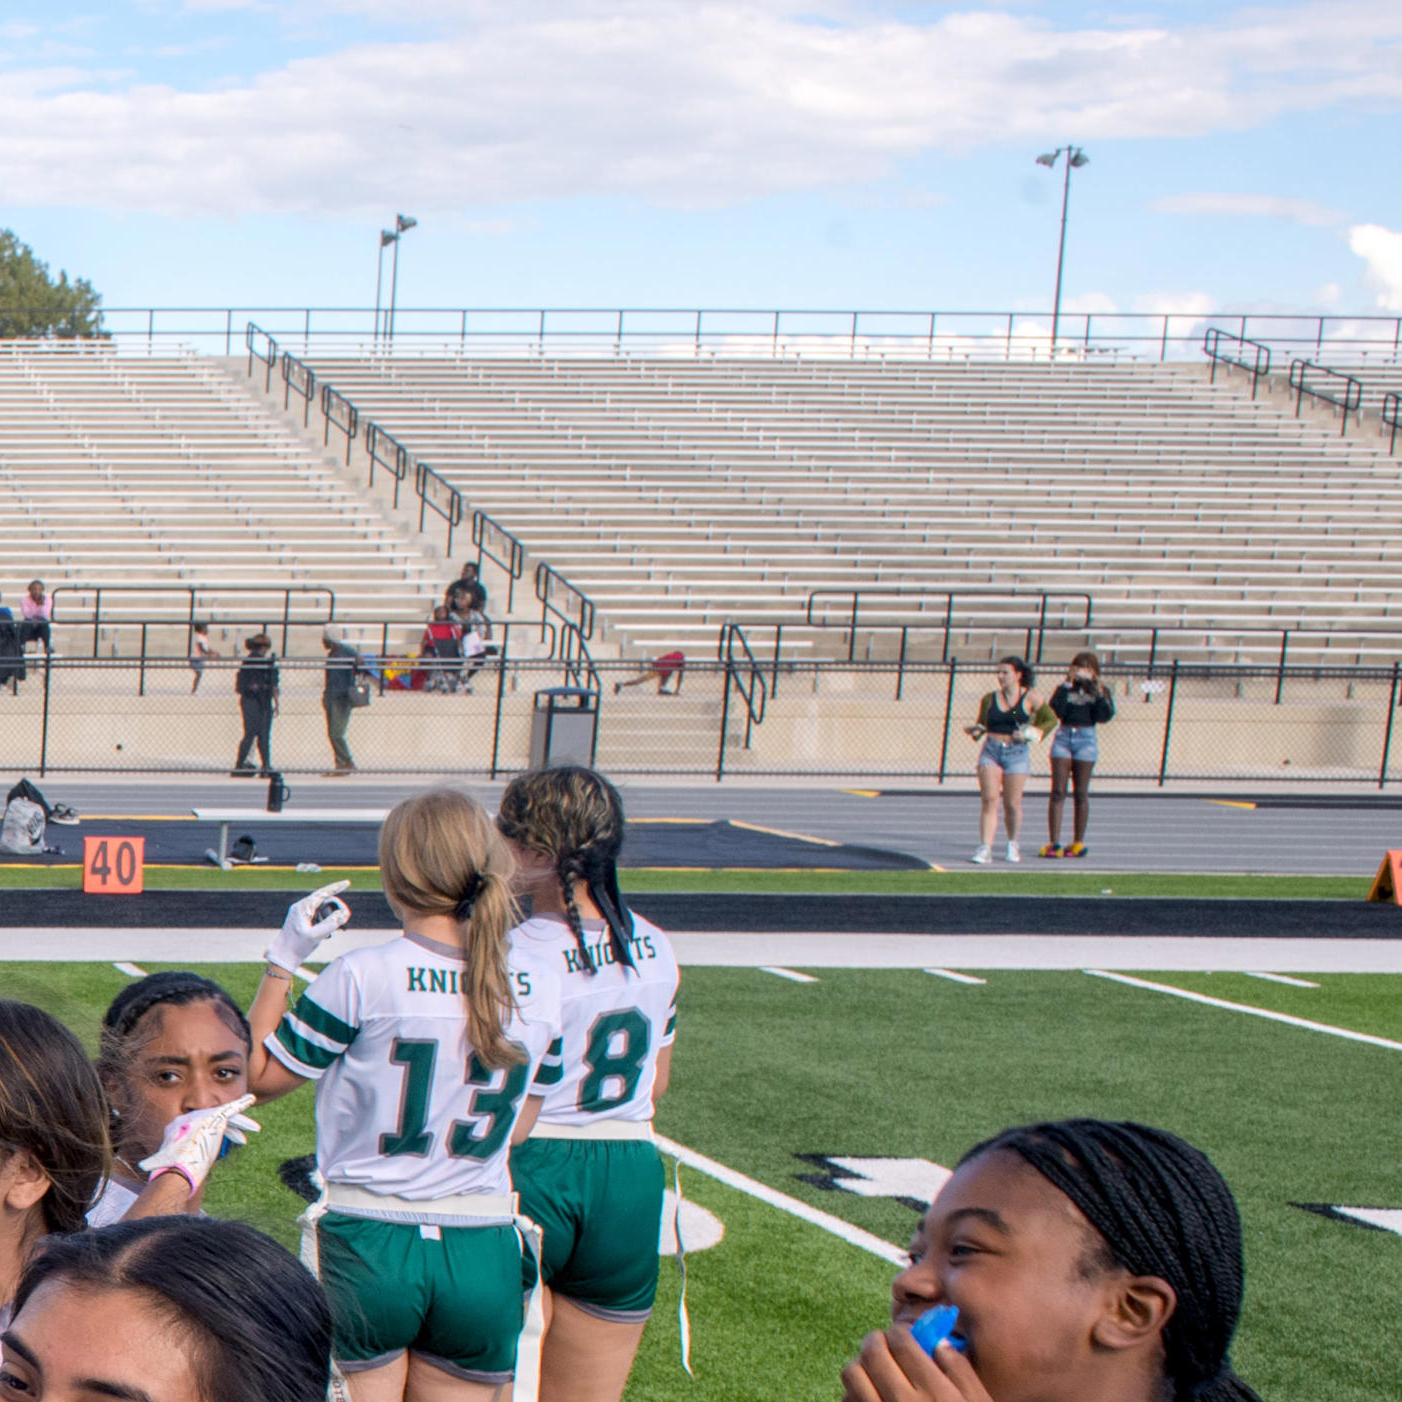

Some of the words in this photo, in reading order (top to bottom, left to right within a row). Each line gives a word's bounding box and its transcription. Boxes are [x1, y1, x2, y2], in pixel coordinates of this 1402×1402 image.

[90, 841, 136, 886] 40
[406, 967, 532, 996] KNIS
[577, 1006, 652, 1113] 8
[378, 1037, 530, 1164] 13
